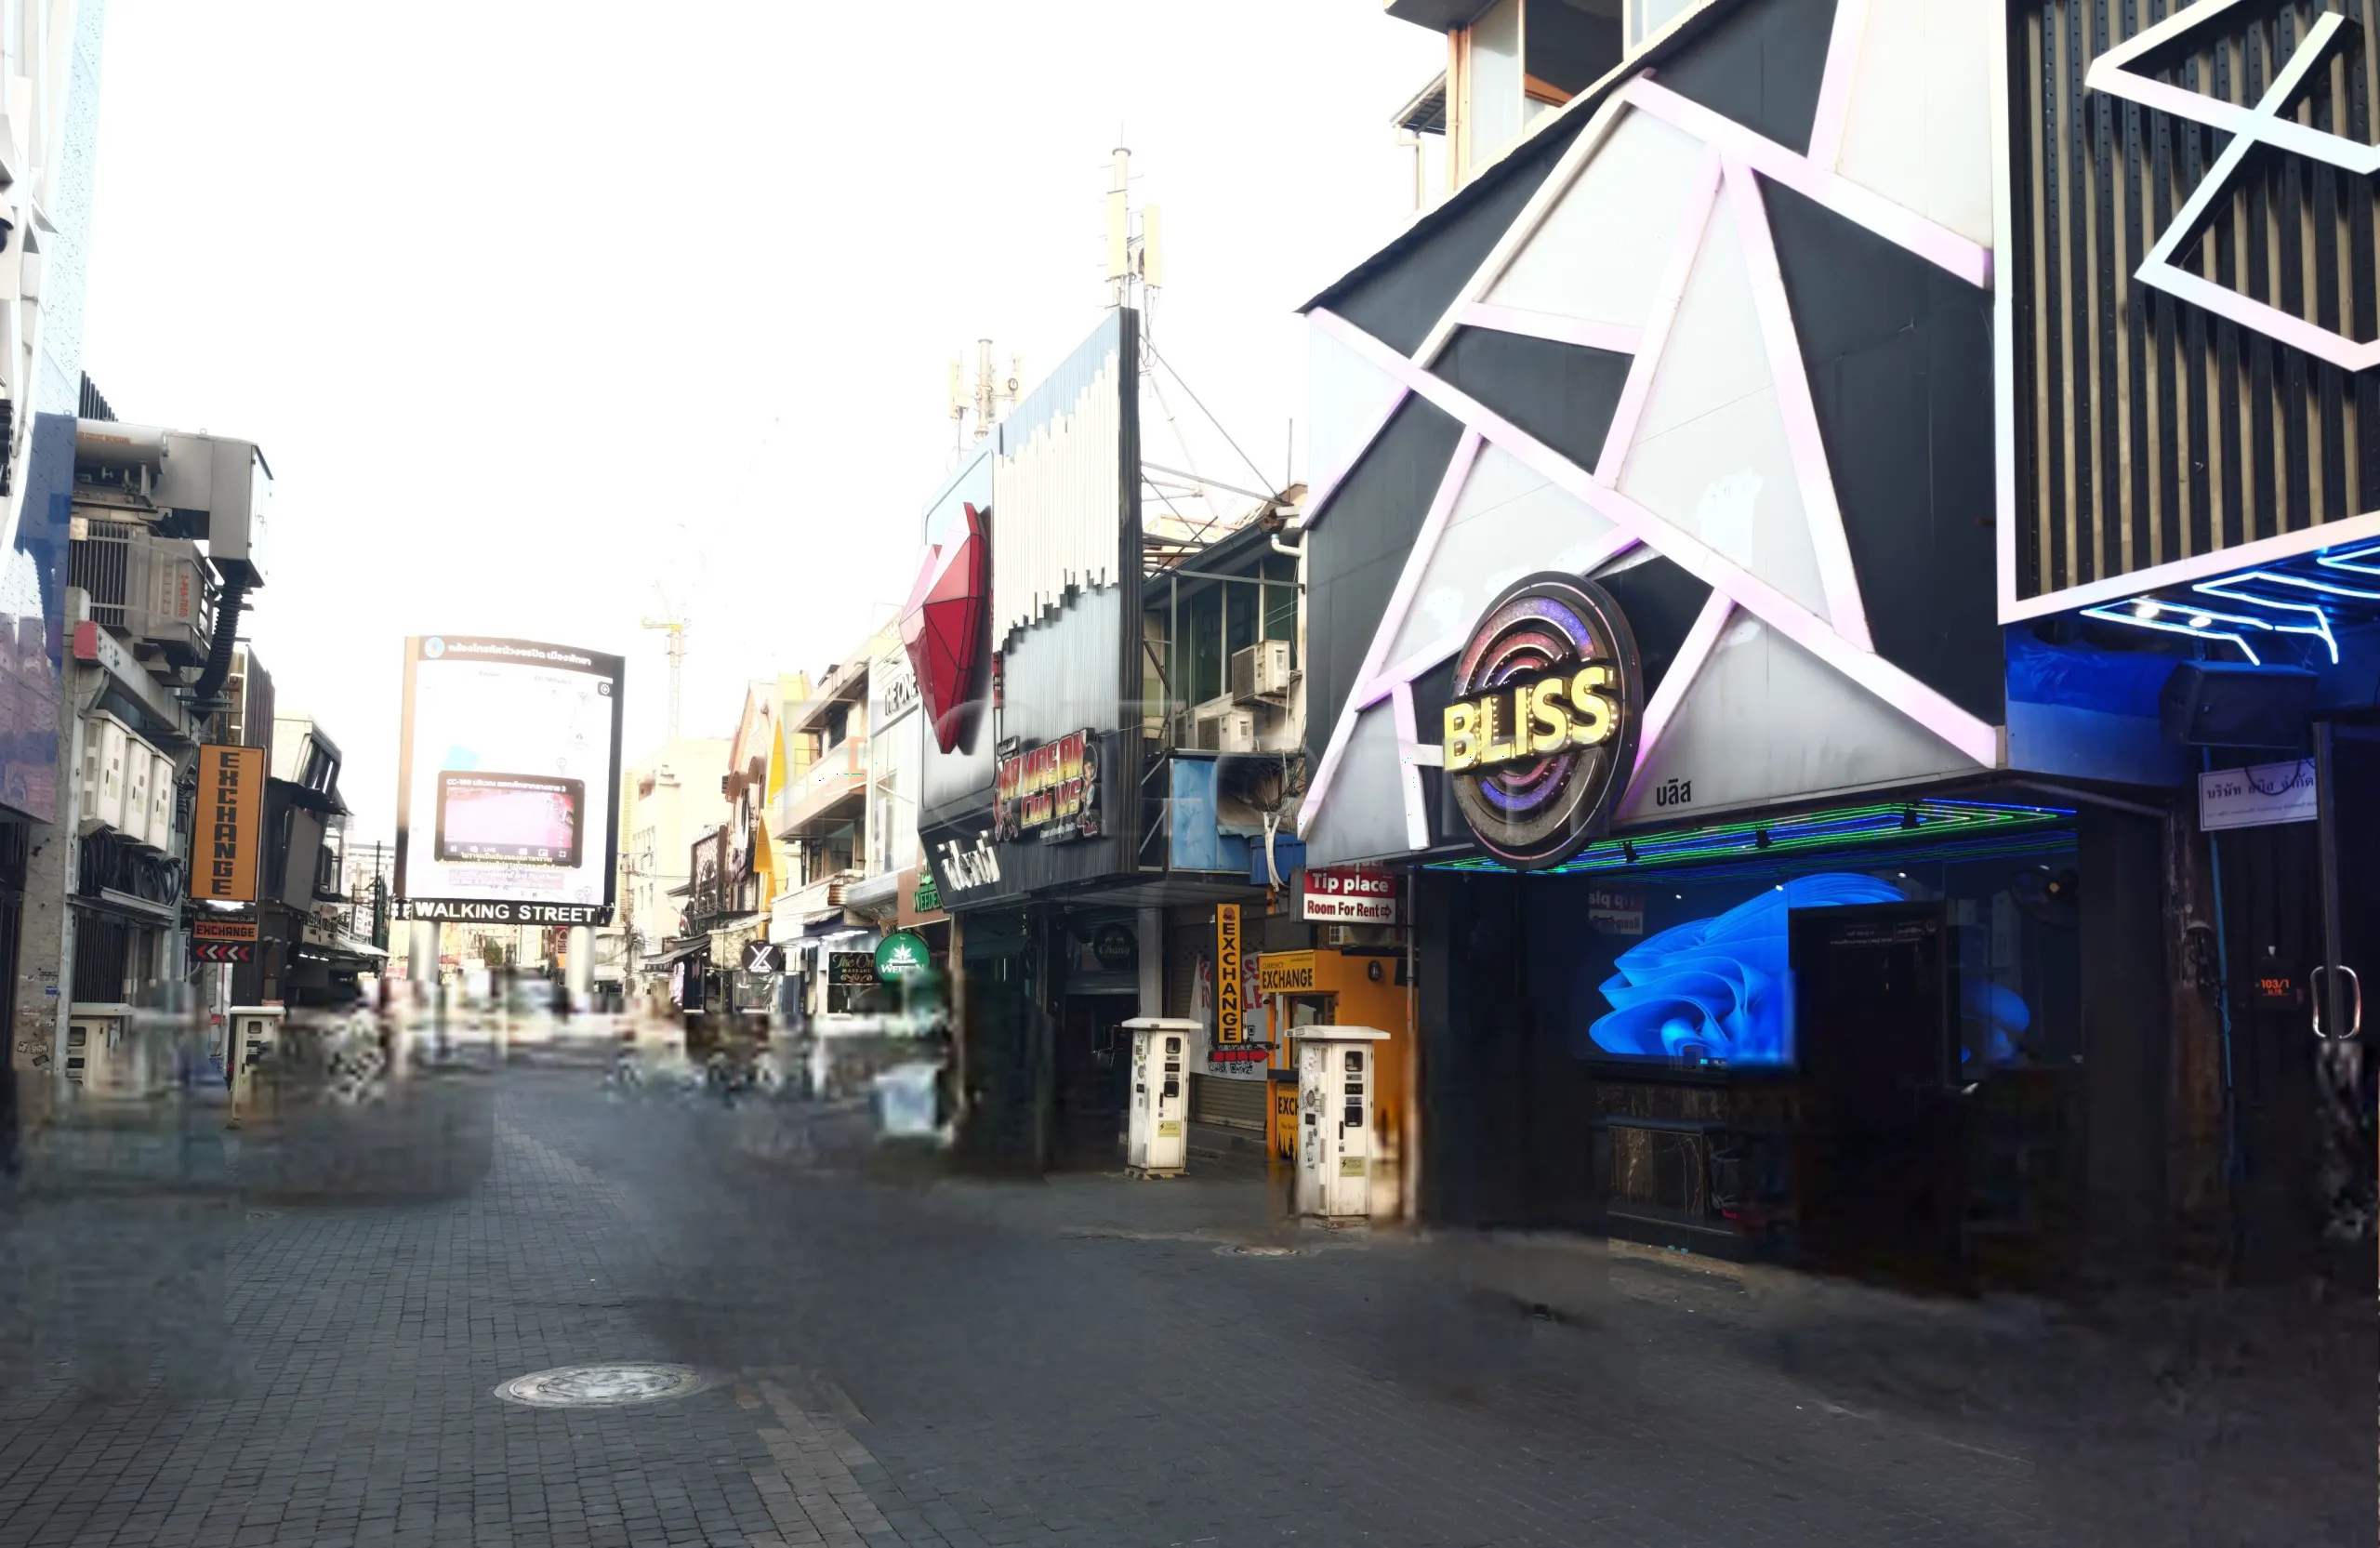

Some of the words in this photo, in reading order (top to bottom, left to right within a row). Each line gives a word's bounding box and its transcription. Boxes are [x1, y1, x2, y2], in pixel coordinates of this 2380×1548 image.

[1444, 666, 1620, 772] BLISS
[211, 751, 240, 895] EXCHANGE
[1313, 872, 1339, 893] Tip
[1343, 874, 1389, 894] place
[415, 901, 510, 920] WALKING
[518, 904, 596, 922] STREET
[1307, 900, 1336, 916] Room
[1339, 902, 1355, 917] For
[1357, 903, 1380, 919] Rent
[196, 925, 255, 937] EXCHANGE
[1099, 944, 1130, 958] Chang
[1222, 922, 1238, 1041] EXCHANGE
[1263, 968, 1313, 989] EXCHANGE
